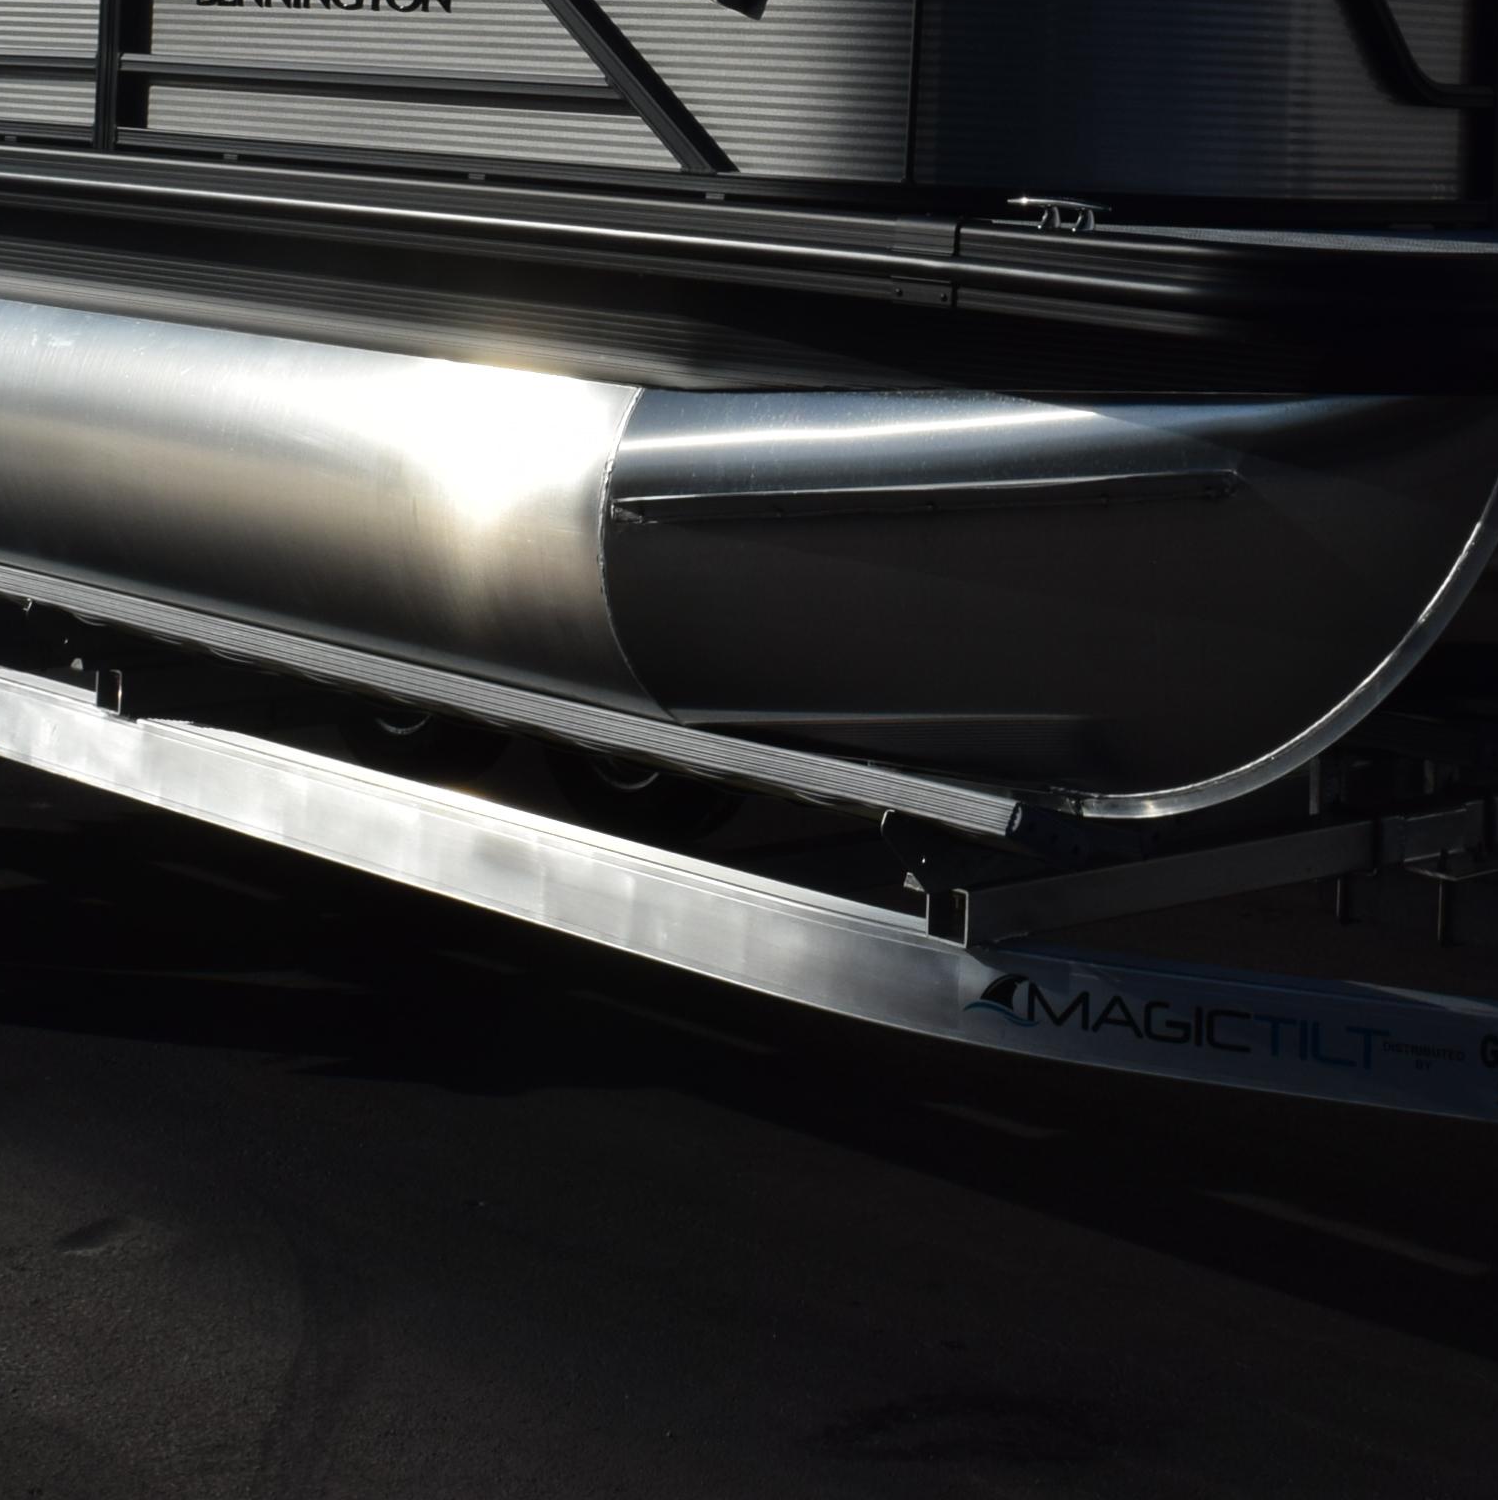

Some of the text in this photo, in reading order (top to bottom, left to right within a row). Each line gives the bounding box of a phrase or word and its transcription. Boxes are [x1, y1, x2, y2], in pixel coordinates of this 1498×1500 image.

[1028, 982, 1390, 1071] MAGICTILT
[1383, 1041, 1466, 1063] DISTRIBUTED
[1415, 1059, 1433, 1071] BY
